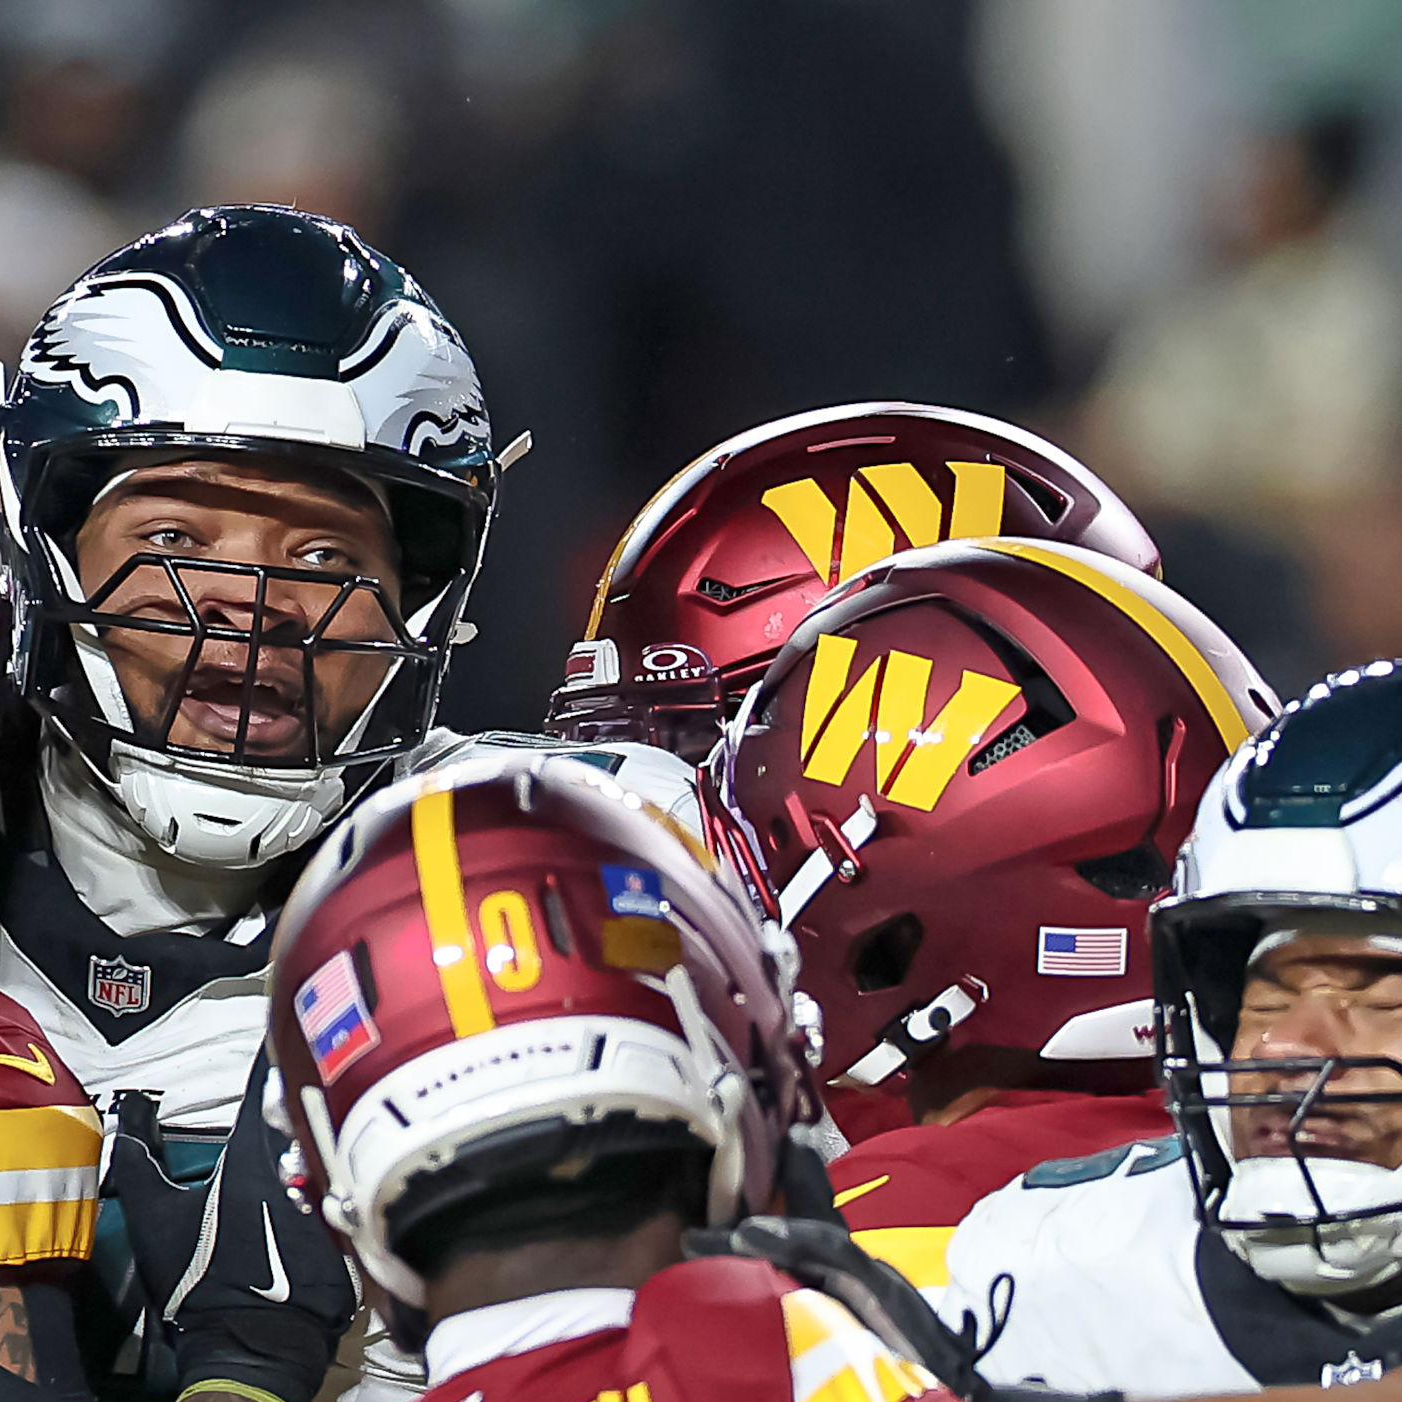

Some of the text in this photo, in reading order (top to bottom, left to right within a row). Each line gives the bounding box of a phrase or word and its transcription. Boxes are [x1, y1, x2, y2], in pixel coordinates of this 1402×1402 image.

[634, 666, 703, 682] OAKLEY
[478, 888, 541, 992] 0
[98, 981, 139, 1006] NFL
